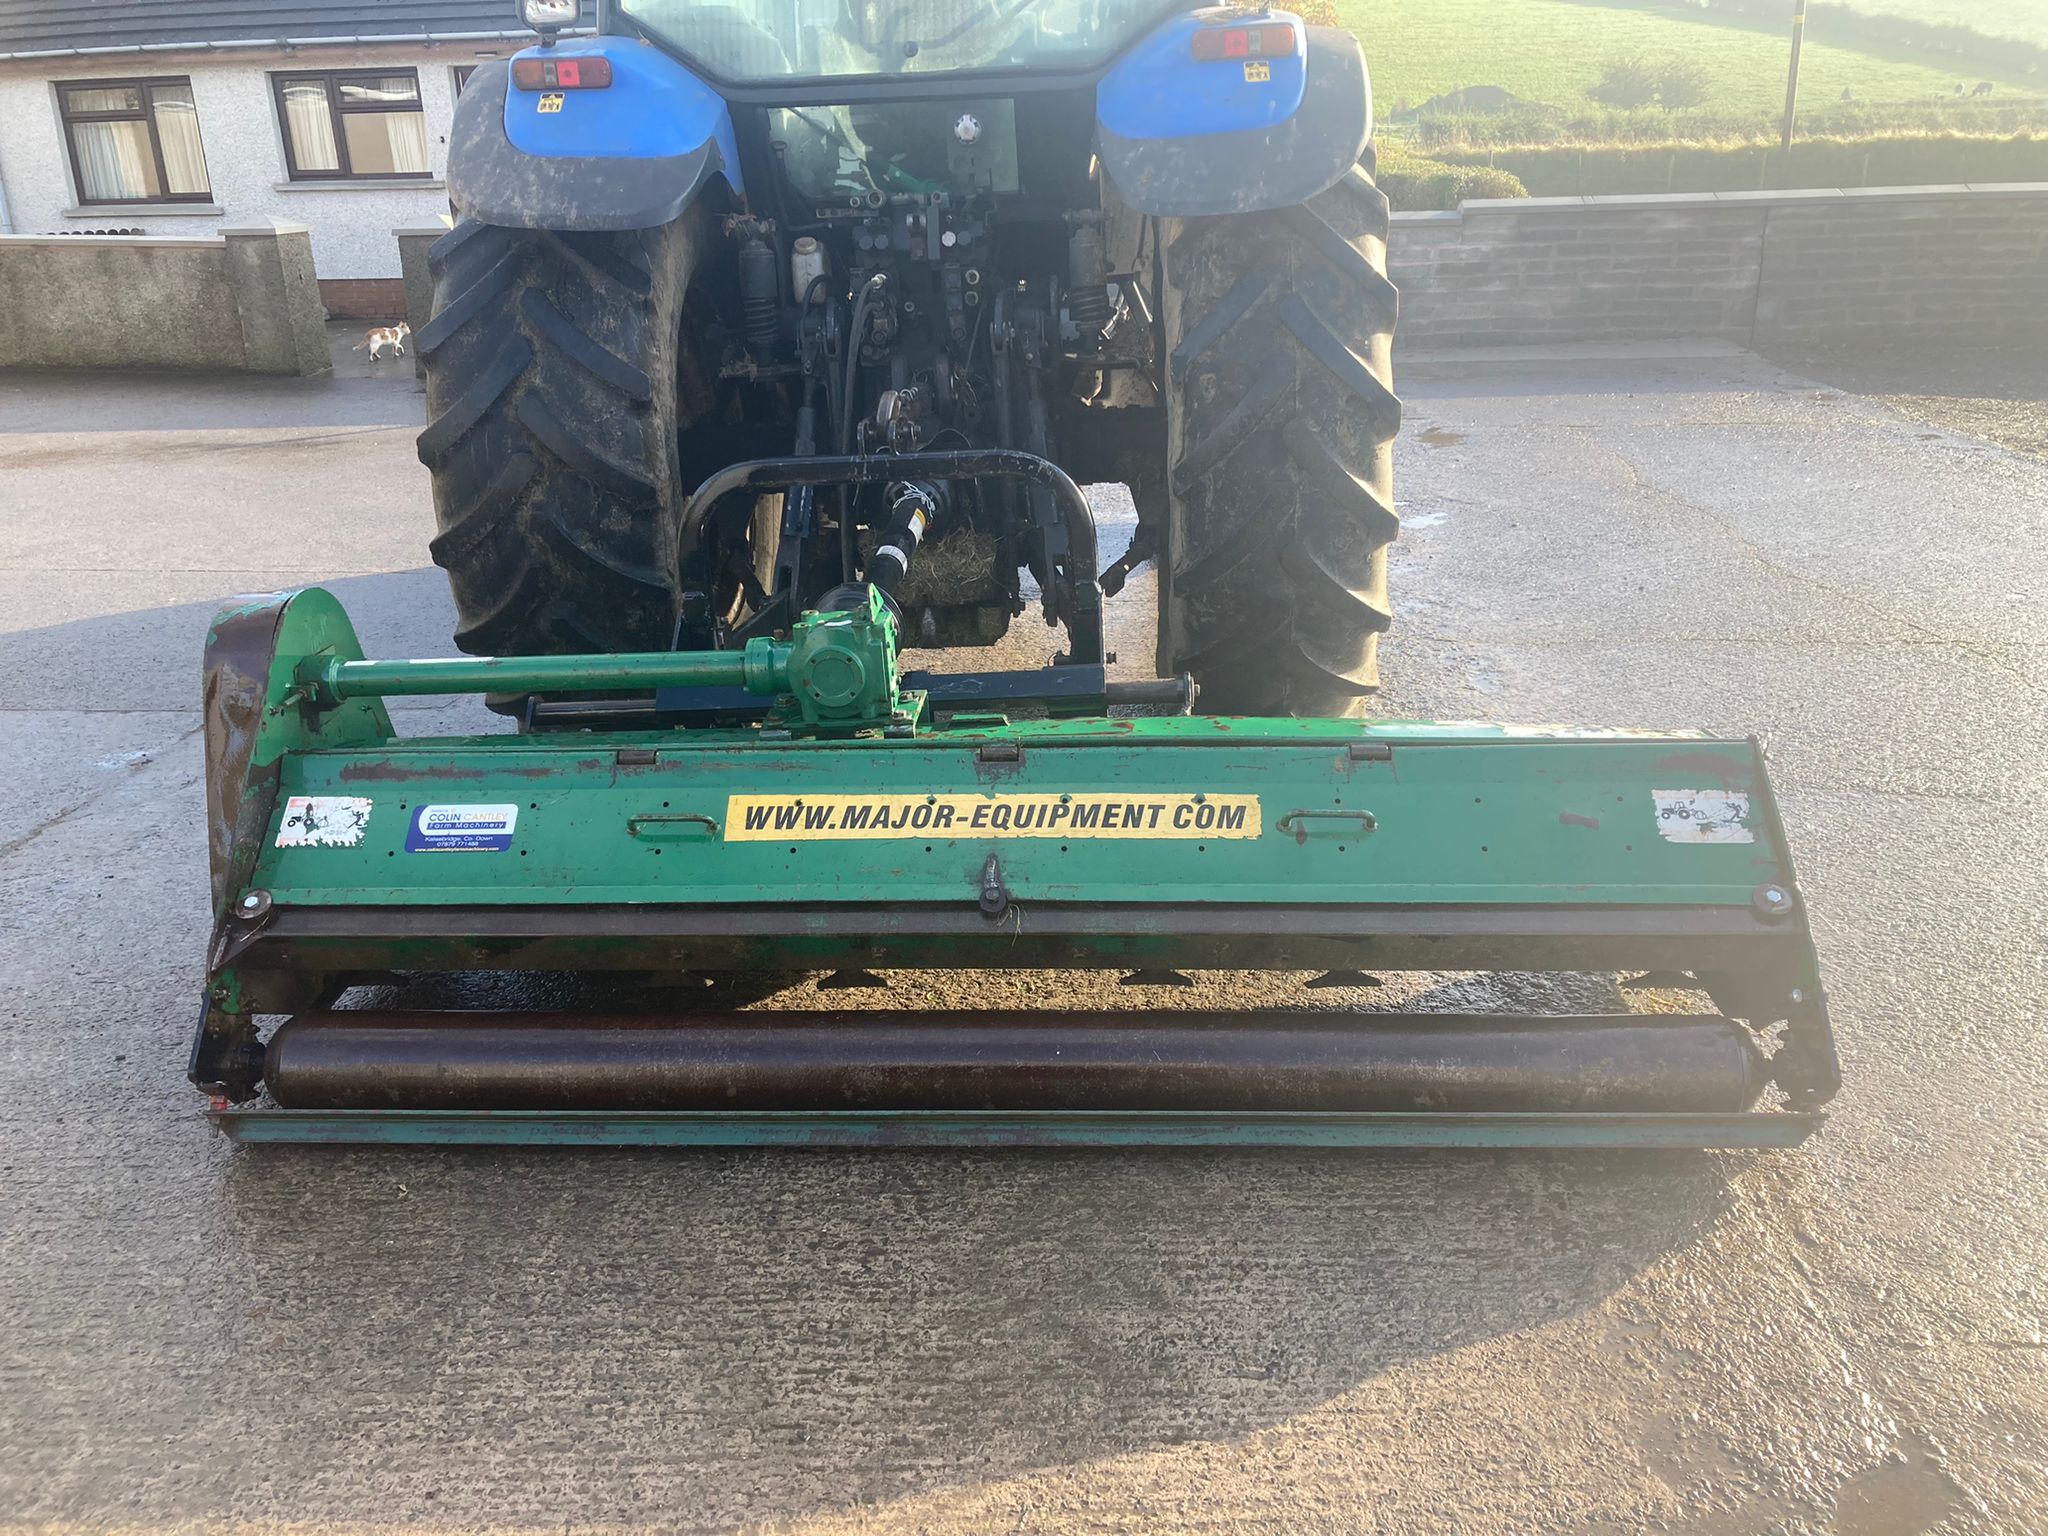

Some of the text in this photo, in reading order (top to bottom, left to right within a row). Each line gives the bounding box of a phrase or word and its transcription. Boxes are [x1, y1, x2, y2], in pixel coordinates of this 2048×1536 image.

[429, 813, 508, 822] COLIN CANTLEY
[429, 821, 504, 830] Farm Machinery
